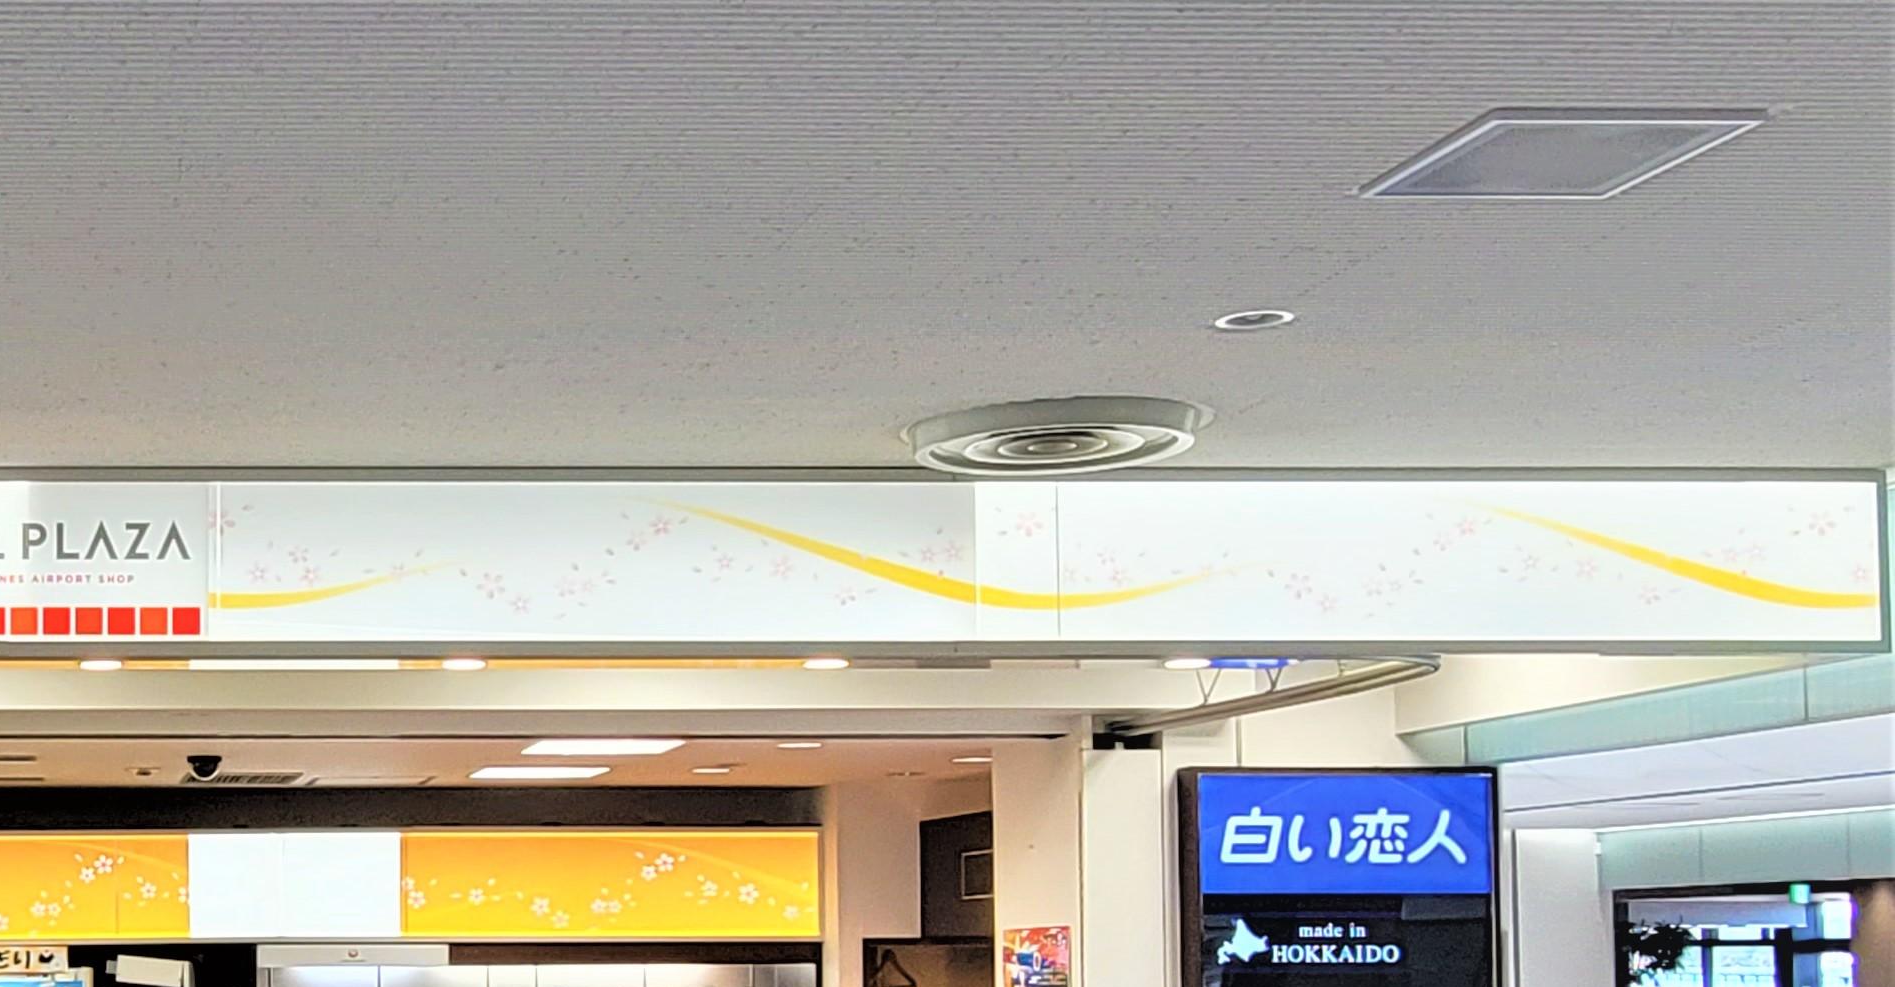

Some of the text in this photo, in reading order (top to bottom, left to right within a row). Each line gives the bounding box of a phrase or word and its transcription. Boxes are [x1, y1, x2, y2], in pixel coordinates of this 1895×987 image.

[22, 521, 191, 560] PLAZA
[32, 574, 91, 584] AIRPORT
[98, 574, 136, 584] SHOP
[1220, 806, 1467, 865] 白い恋人
[1298, 922, 1366, 938] made in
[1271, 944, 1401, 963] HOKKAIDO
